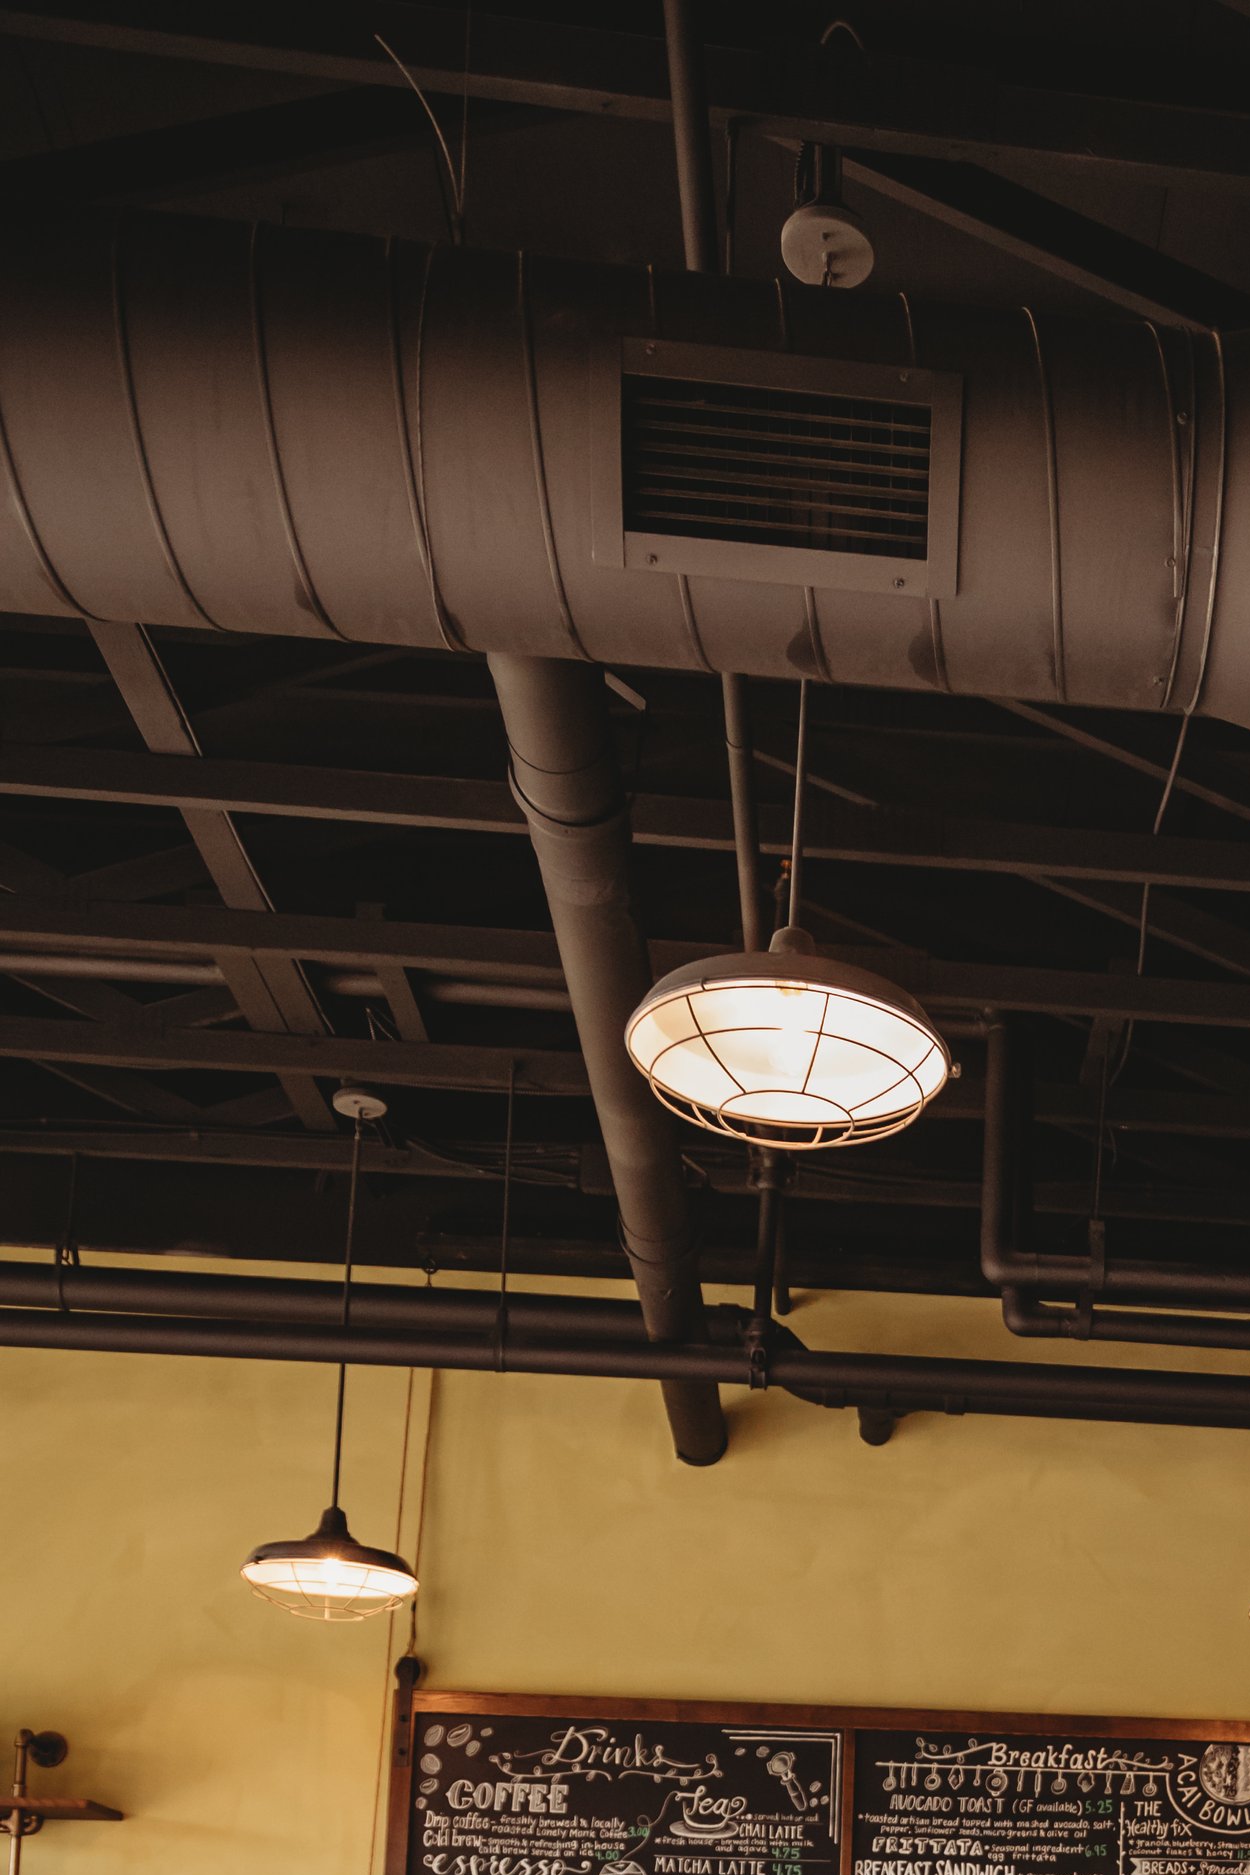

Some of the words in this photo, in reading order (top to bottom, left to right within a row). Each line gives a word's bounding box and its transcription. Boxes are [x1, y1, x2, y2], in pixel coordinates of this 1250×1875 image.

[542, 1726, 699, 1768] Drinks
[988, 1743, 1108, 1769] Breakfast
[1177, 1753, 1201, 1808] ACAI
[446, 1779, 570, 1814] COFFEE
[675, 1786, 747, 1817] Tea
[890, 1795, 951, 1812] AVOCADO
[957, 1796, 1004, 1814] TOAST
[1085, 1800, 1113, 1814] 5.25
[1134, 1801, 1162, 1816] THE
[424, 1810, 448, 1829] Drip
[500, 1815, 536, 1830] freshly
[539, 1816, 577, 1829] brewed
[591, 1816, 625, 1830] locally
[933, 1816, 959, 1827] bread
[1126, 1818, 1169, 1839] Healthy
[1171, 1820, 1192, 1837] fix
[423, 1830, 449, 1847] Cold
[739, 1823, 766, 1837] CHAI
[770, 1824, 804, 1839] LATTE
[772, 1848, 800, 1859] 4.75
[872, 1836, 983, 1856] FRITTATA
[655, 1858, 712, 1874] MATCHA
